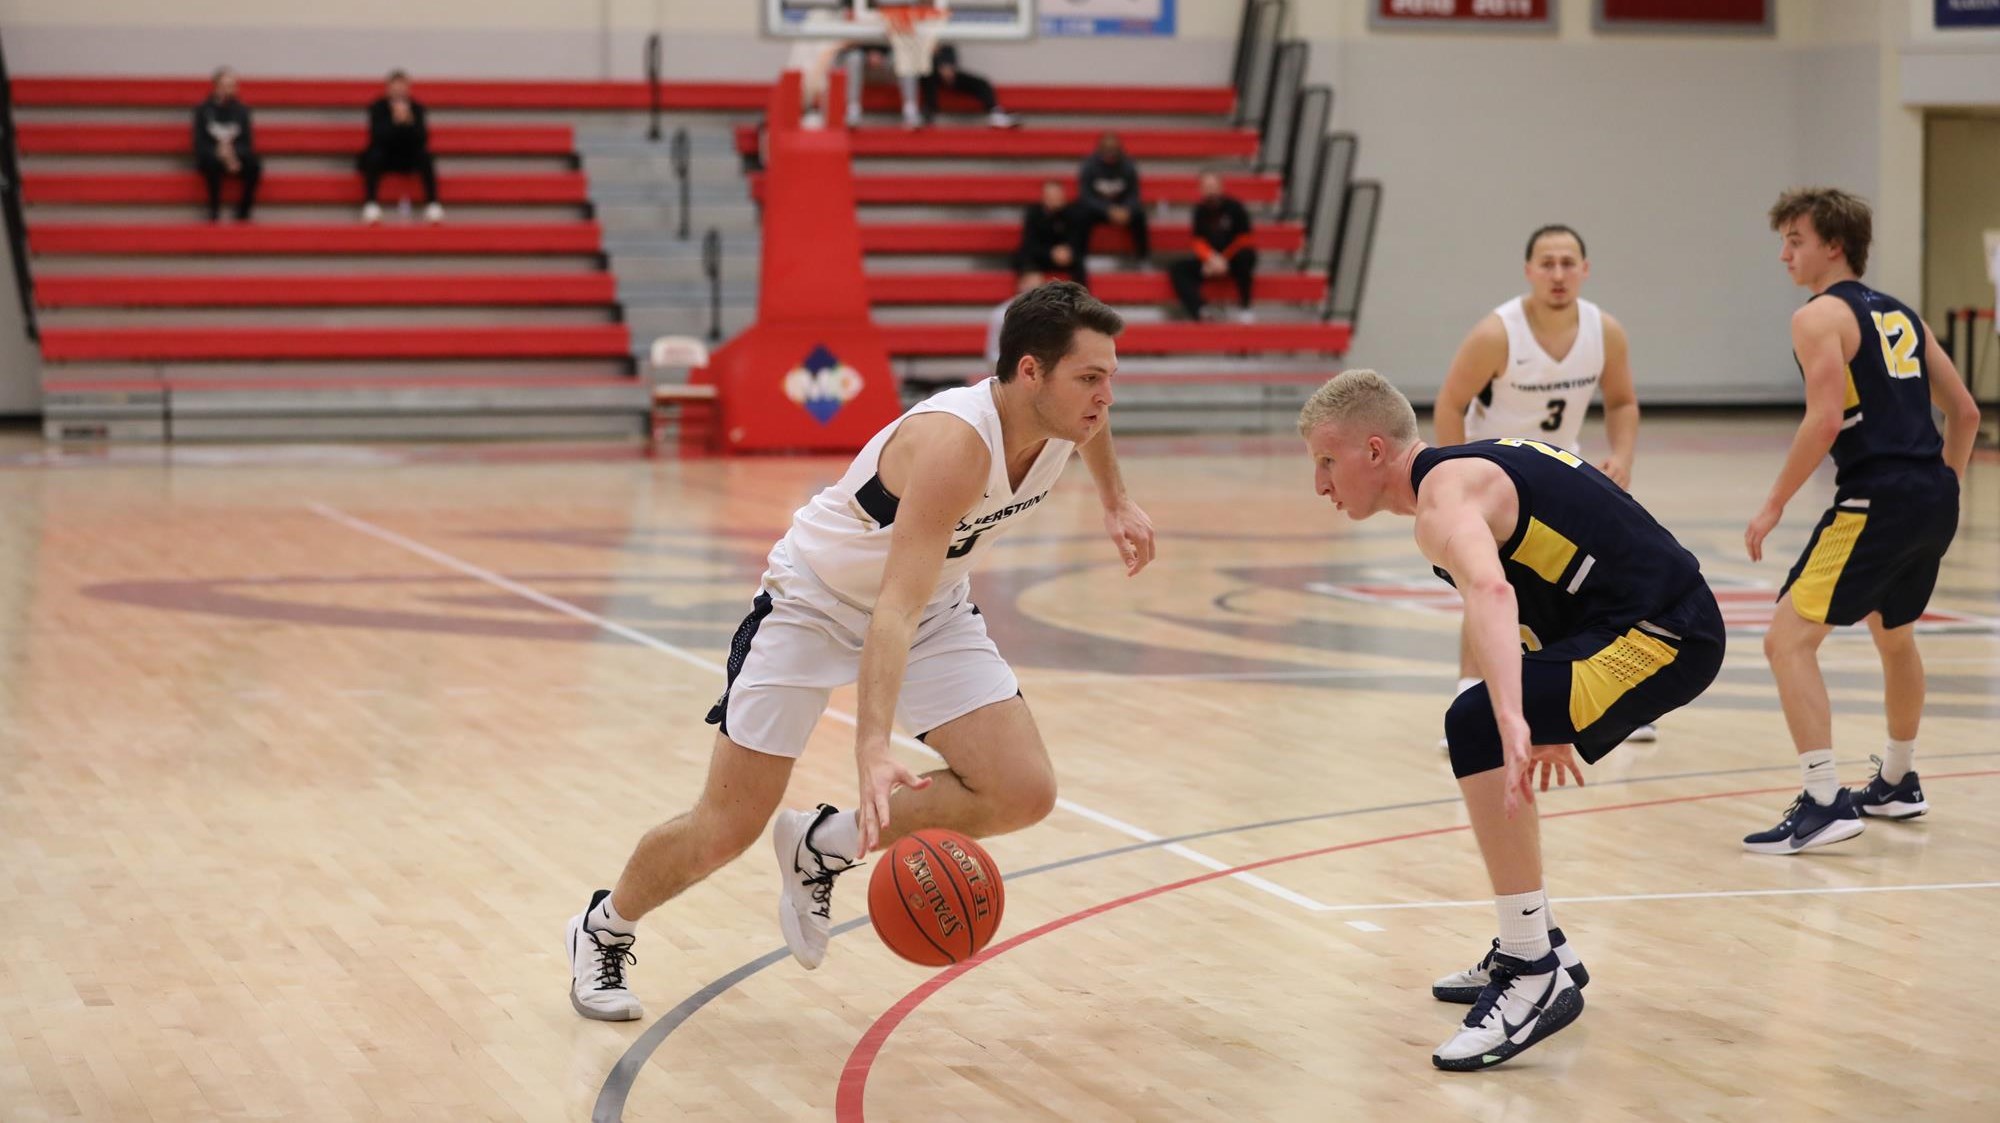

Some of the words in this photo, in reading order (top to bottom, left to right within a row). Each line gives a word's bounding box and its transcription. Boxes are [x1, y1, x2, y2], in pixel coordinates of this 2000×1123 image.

[1870, 309, 1921, 379] 12
[1540, 399, 1566, 432] 3
[903, 849, 964, 937] SPALDING
